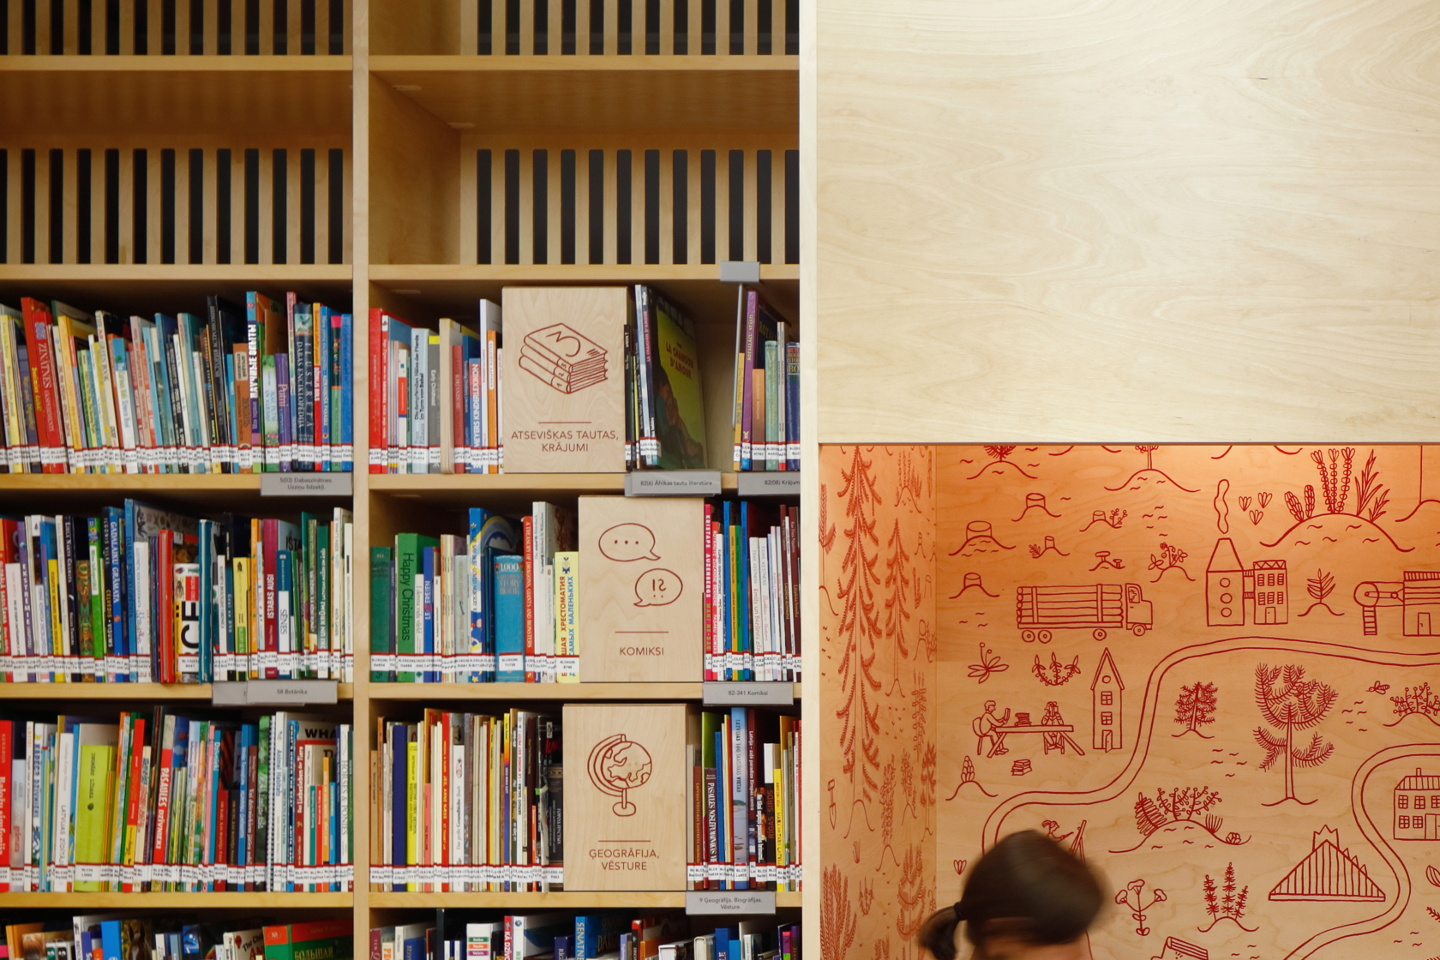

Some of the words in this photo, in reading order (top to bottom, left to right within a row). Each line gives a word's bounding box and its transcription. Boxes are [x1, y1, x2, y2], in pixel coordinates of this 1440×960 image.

[511, 428, 573, 442] ATSEVIŠĶAS
[576, 430, 619, 442] TAUTAS,
[541, 441, 589, 452] KRĀJUMI
[781, 480, 801, 488] Krājum
[402, 552, 414, 586] Happy
[402, 588, 414, 641] Christmas
[619, 647, 665, 656] KOMIKSI
[589, 848, 660, 860] ĢEOGRĀFIJA,
[601, 860, 648, 870] VĒSTURE
